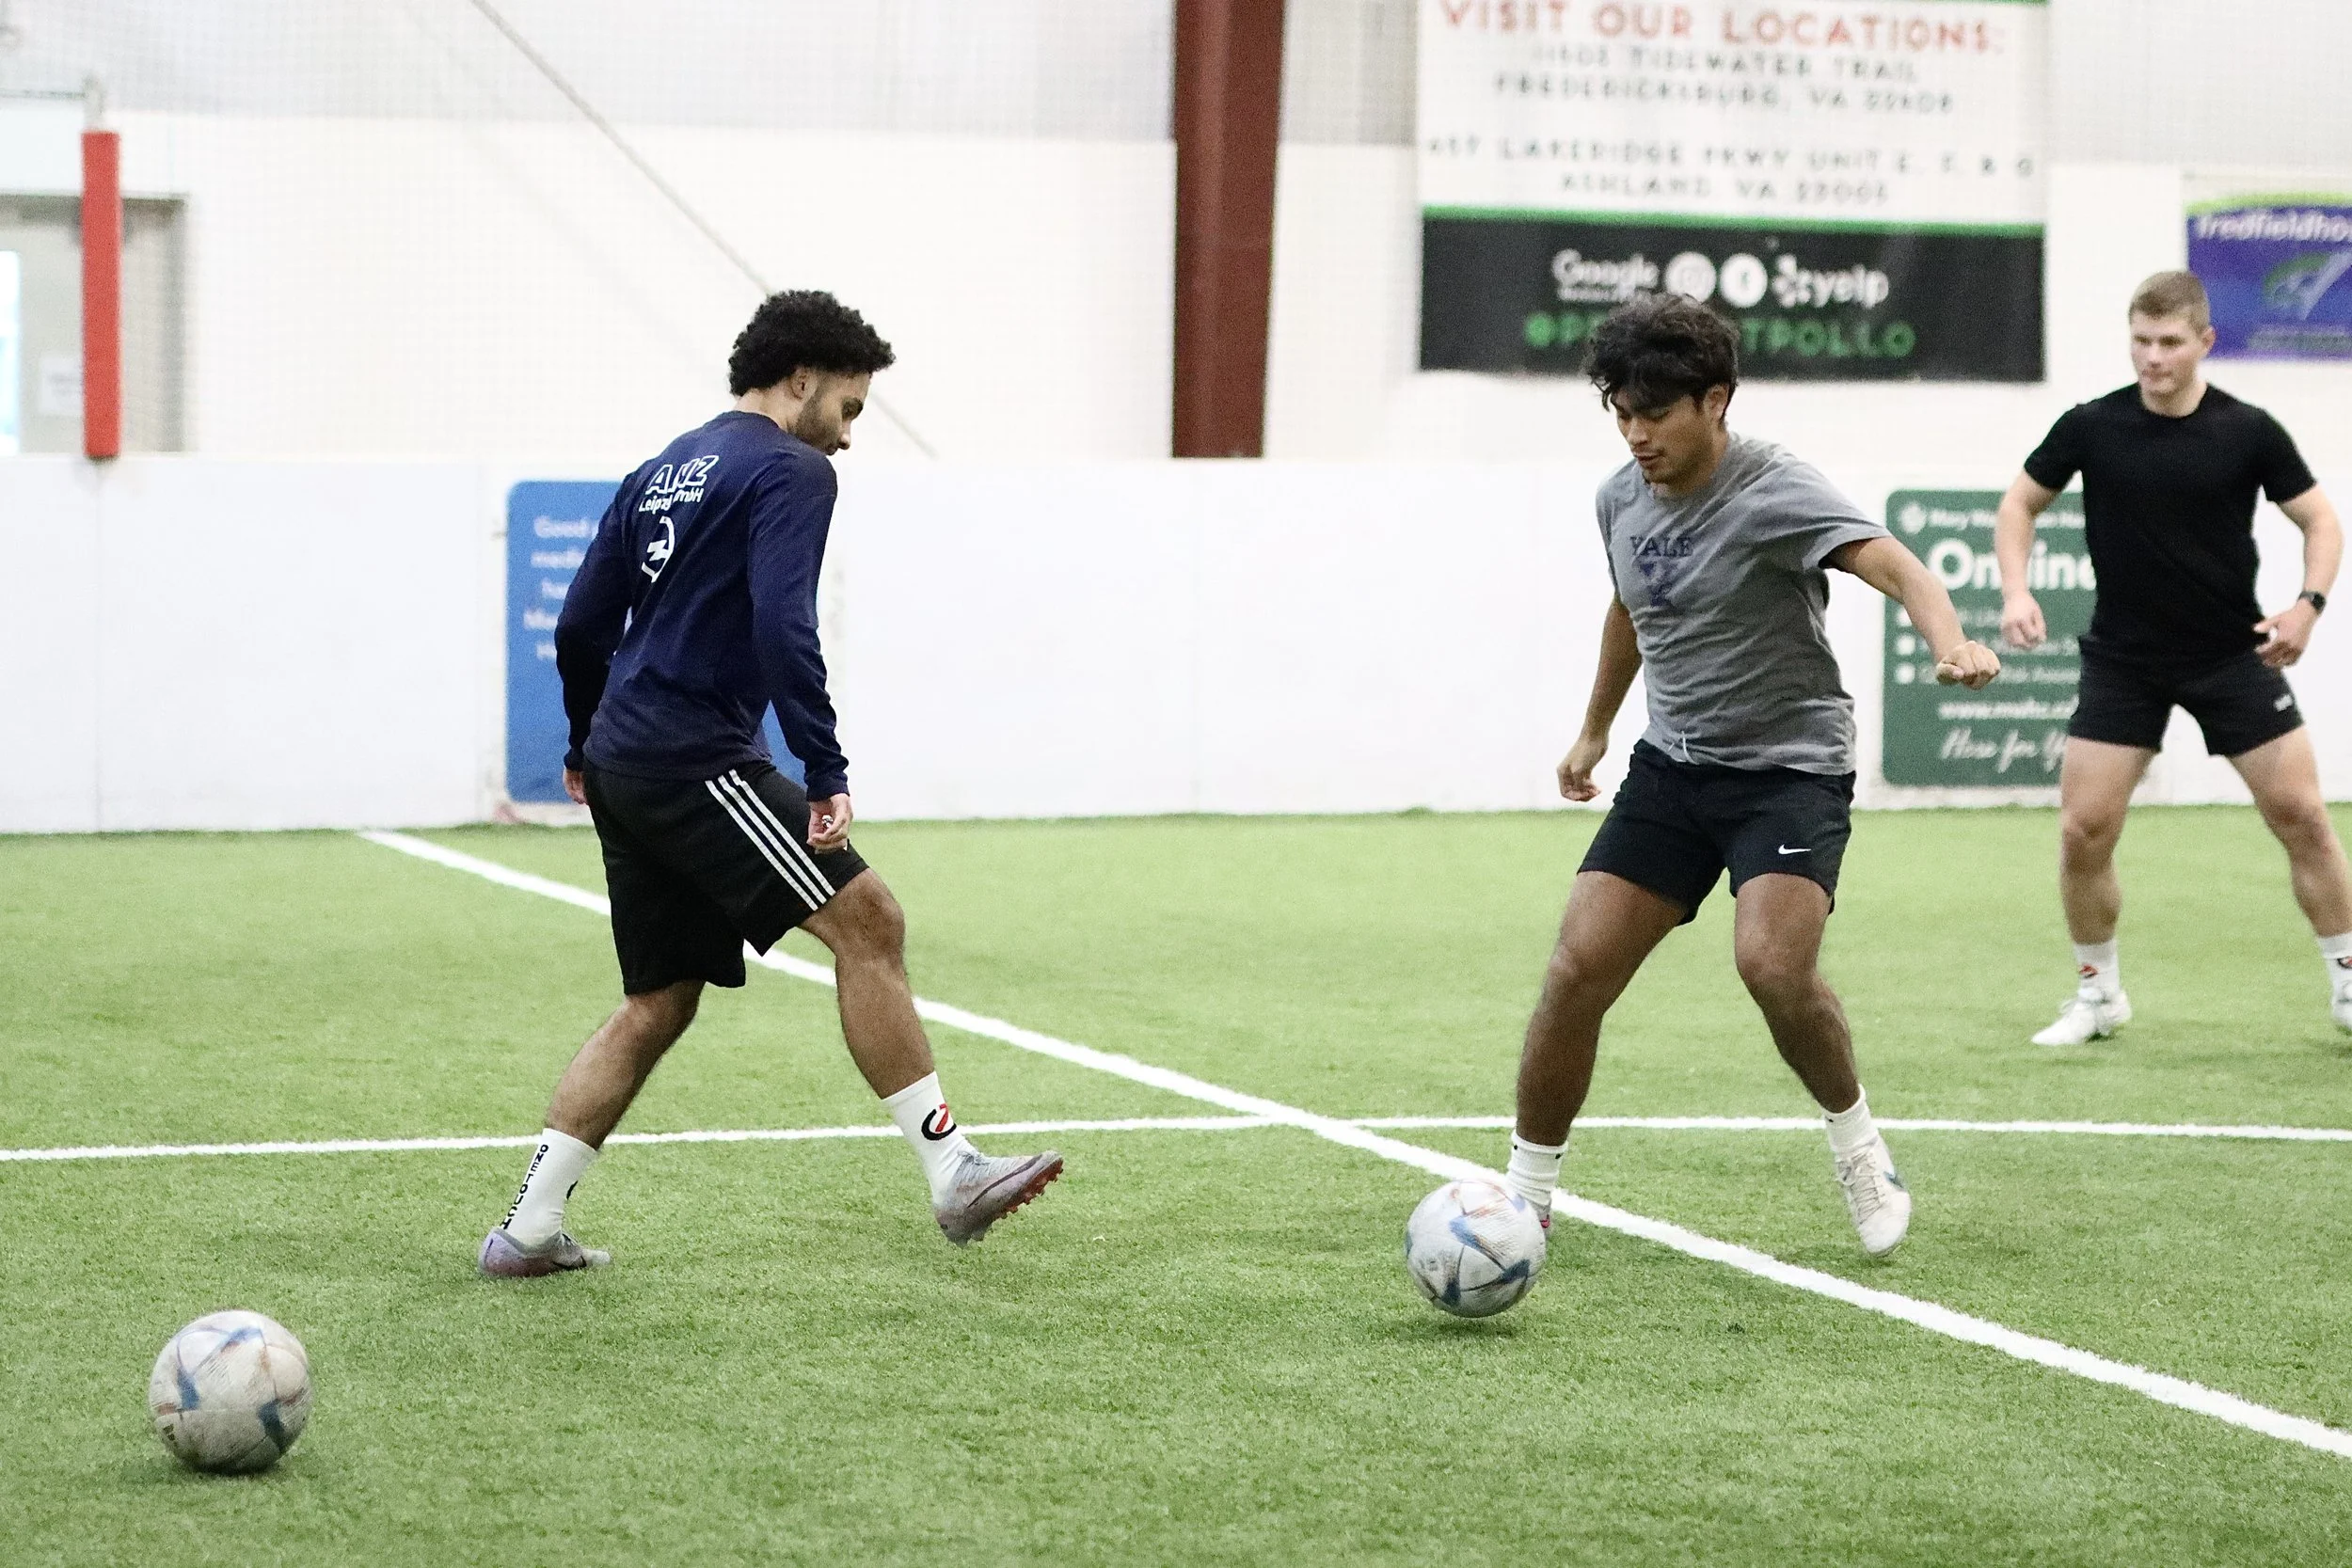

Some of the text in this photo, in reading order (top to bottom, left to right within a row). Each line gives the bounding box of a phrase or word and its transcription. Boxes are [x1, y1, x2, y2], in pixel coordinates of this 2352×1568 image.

[1442, 0, 2004, 55] VISIT OUR LOCATIONS:
[673, 487, 705, 503] mbH
[1629, 534, 1692, 558] YALE
